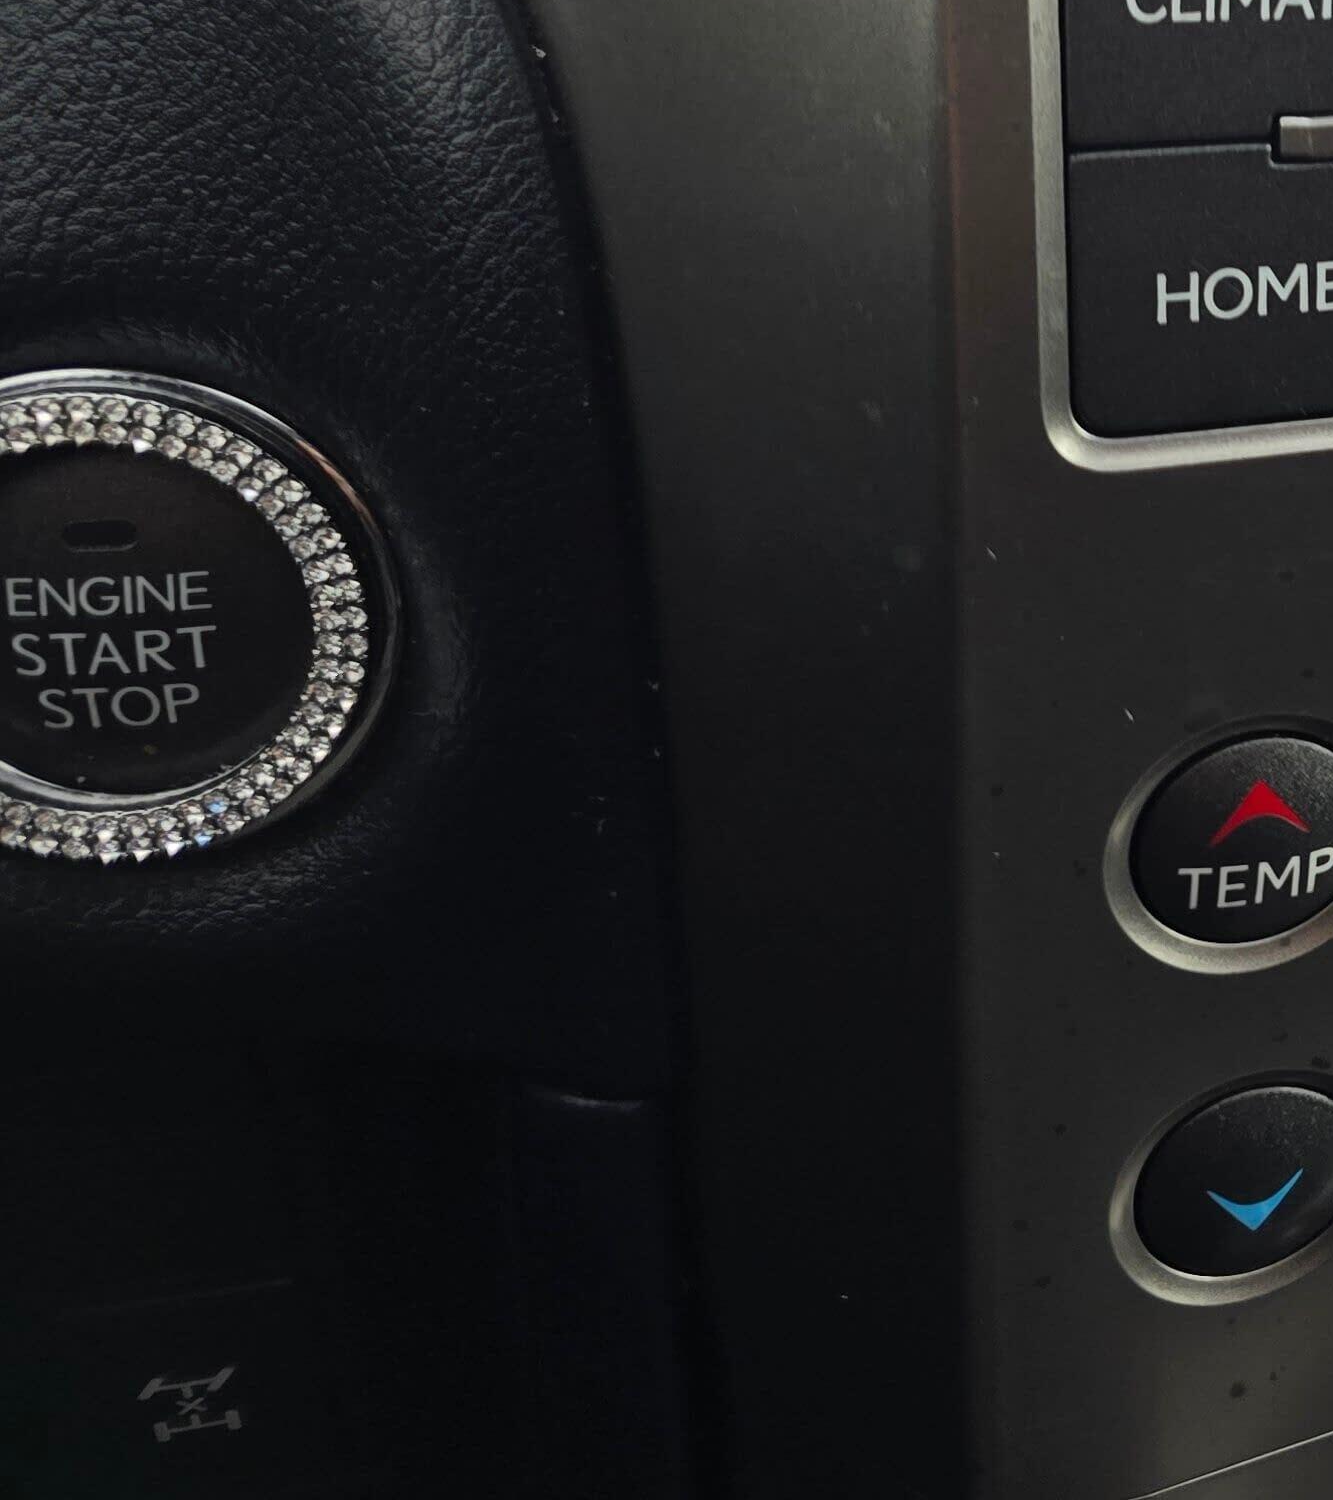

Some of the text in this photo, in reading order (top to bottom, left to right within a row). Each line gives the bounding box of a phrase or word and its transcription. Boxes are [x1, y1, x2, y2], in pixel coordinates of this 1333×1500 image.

[4, 570, 213, 618] ENGINE
[11, 624, 217, 677] START
[38, 682, 200, 730] STOP
